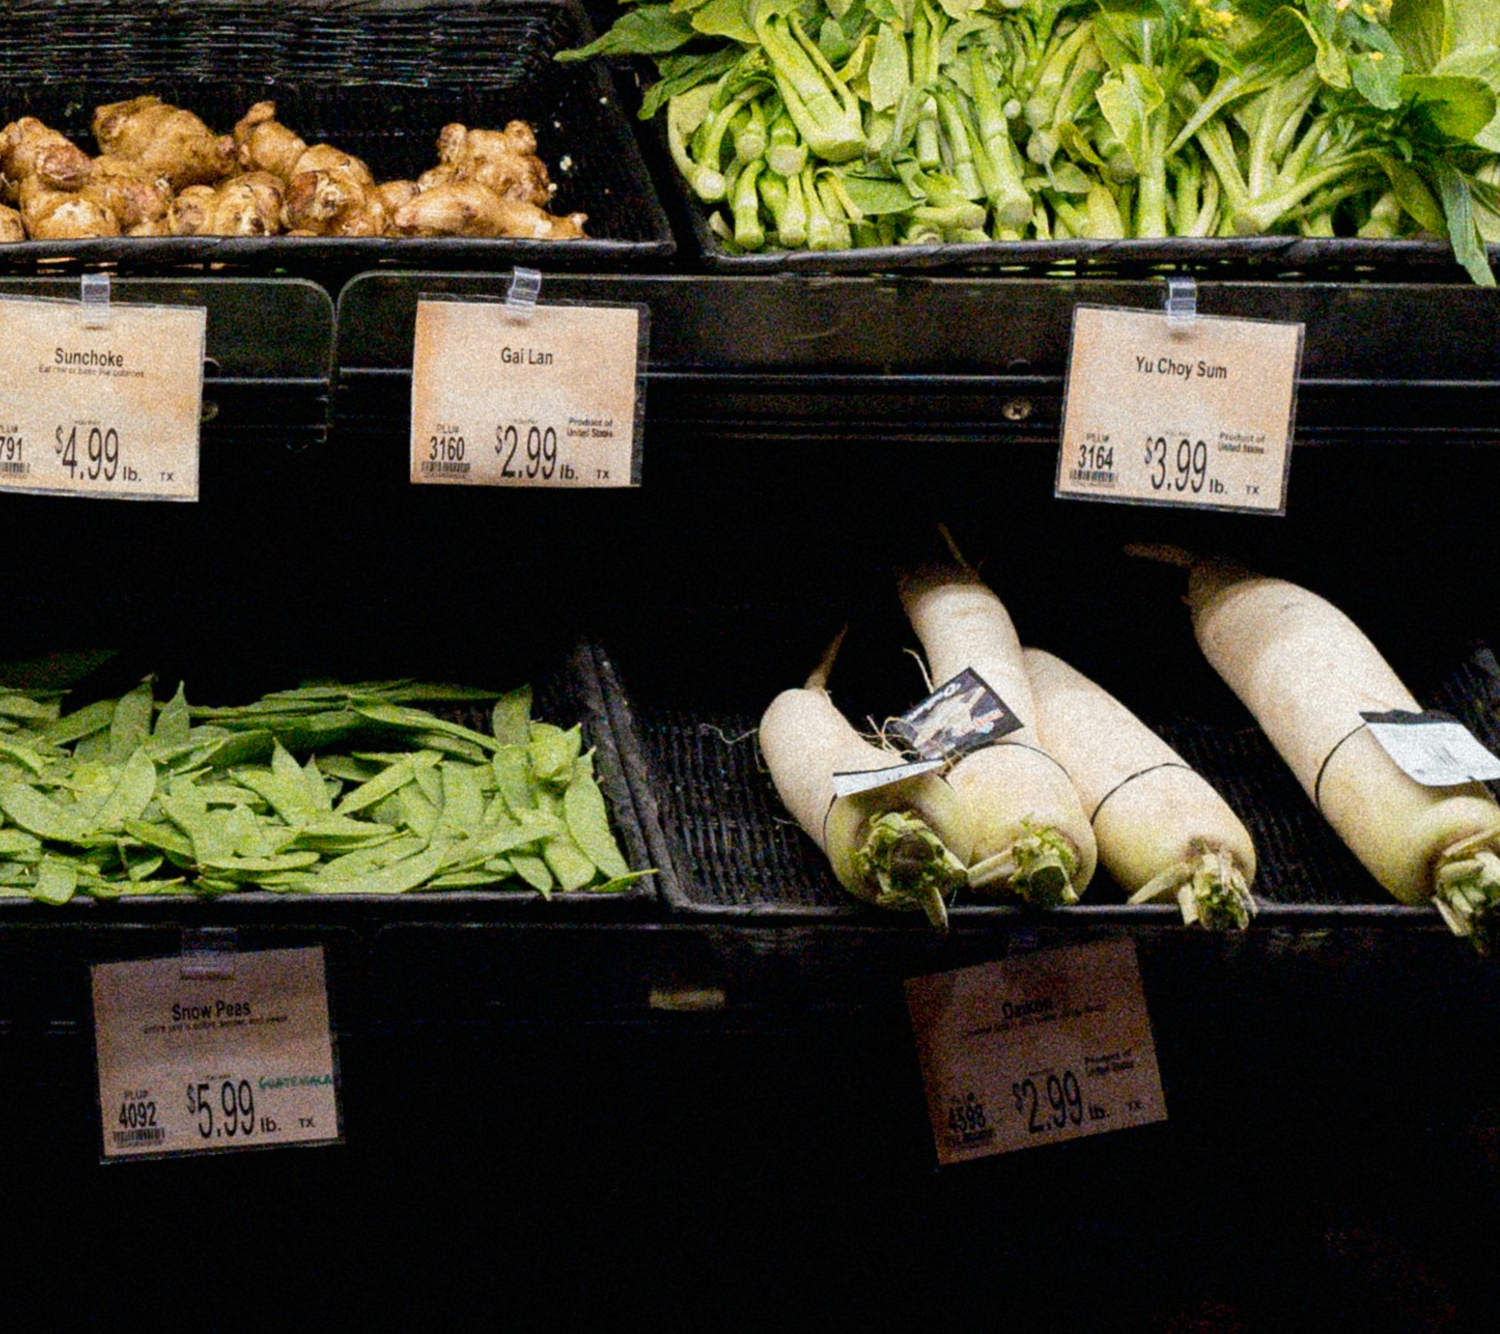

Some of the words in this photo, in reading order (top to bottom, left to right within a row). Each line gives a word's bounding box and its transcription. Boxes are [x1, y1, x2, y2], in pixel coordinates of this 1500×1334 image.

[54, 347, 124, 368] Sunchoke
[501, 347, 524, 365] Gai
[528, 348, 553, 365] Lan
[1135, 355, 1153, 374] Yu
[1157, 357, 1192, 381] Choy
[1197, 360, 1228, 379] Sum
[55, 425, 119, 482] $4.99
[122, 466, 143, 483] lb.
[429, 435, 465, 462] 3160
[495, 425, 558, 480] $2.99
[559, 464, 580, 481] lb.
[1078, 444, 1114, 471] 3164
[160, 471, 175, 482] TX
[596, 468, 610, 480] TX
[1144, 435, 1208, 494] $3.99
[1208, 478, 1229, 496] lb.
[1245, 484, 1260, 496] TX
[172, 1002, 212, 1022] Snow
[216, 1000, 251, 1018] Peas
[119, 1101, 157, 1129] 4092
[186, 1079, 255, 1139] $5.99
[260, 1117, 282, 1134] lb.
[1012, 1070, 1083, 1135] $2.99
[298, 1117, 315, 1129] TX
